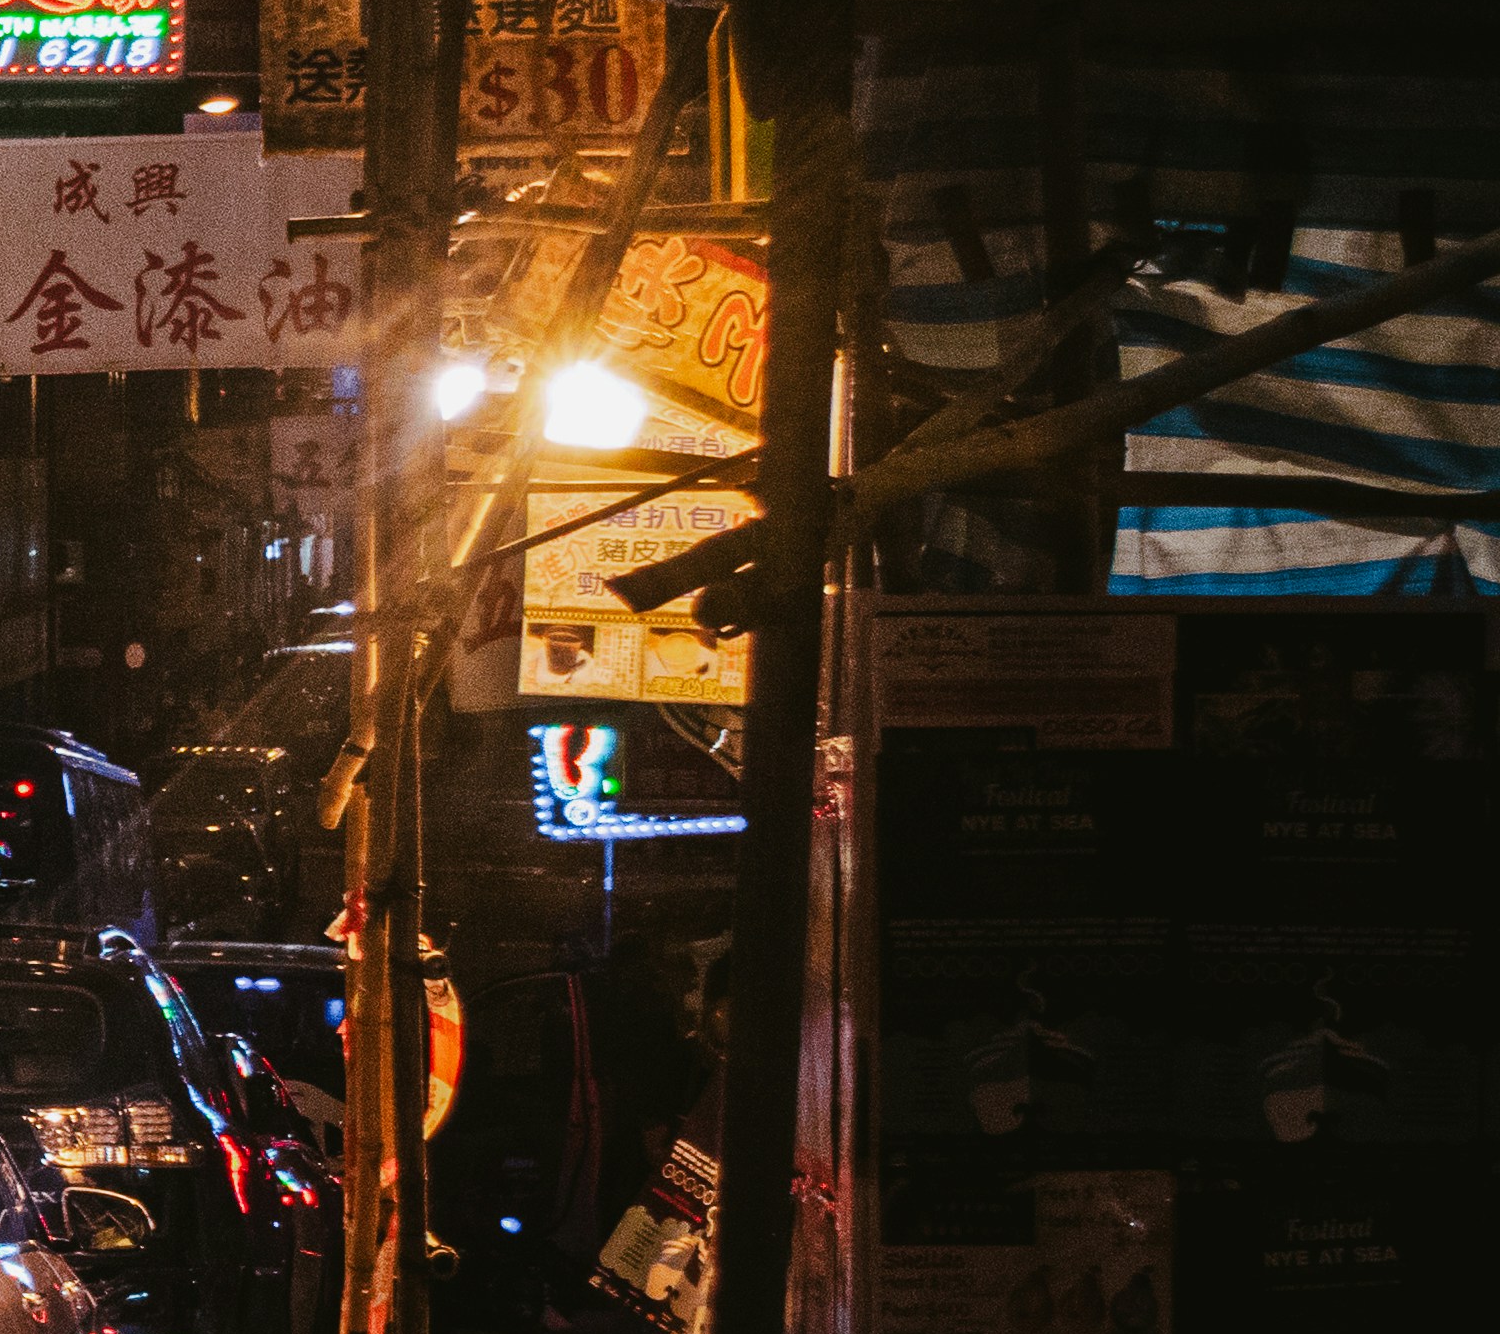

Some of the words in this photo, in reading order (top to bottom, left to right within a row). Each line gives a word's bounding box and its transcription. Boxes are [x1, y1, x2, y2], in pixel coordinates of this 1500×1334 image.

[38, 38, 161, 68] 6218
[52, 158, 188, 224] 成興
[1286, 787, 1377, 815] Festival
[960, 813, 1006, 832] NYE
[1013, 813, 1041, 832] AT
[1049, 813, 1096, 832] SEA
[1262, 821, 1309, 840] NYE
[1316, 821, 1345, 840] AT
[1352, 822, 1398, 841] SEA
[1285, 1216, 1375, 1242] Festival
[1262, 1249, 1310, 1268] NYE
[1318, 1247, 1346, 1265] AT
[1352, 1245, 1399, 1264] SEA
